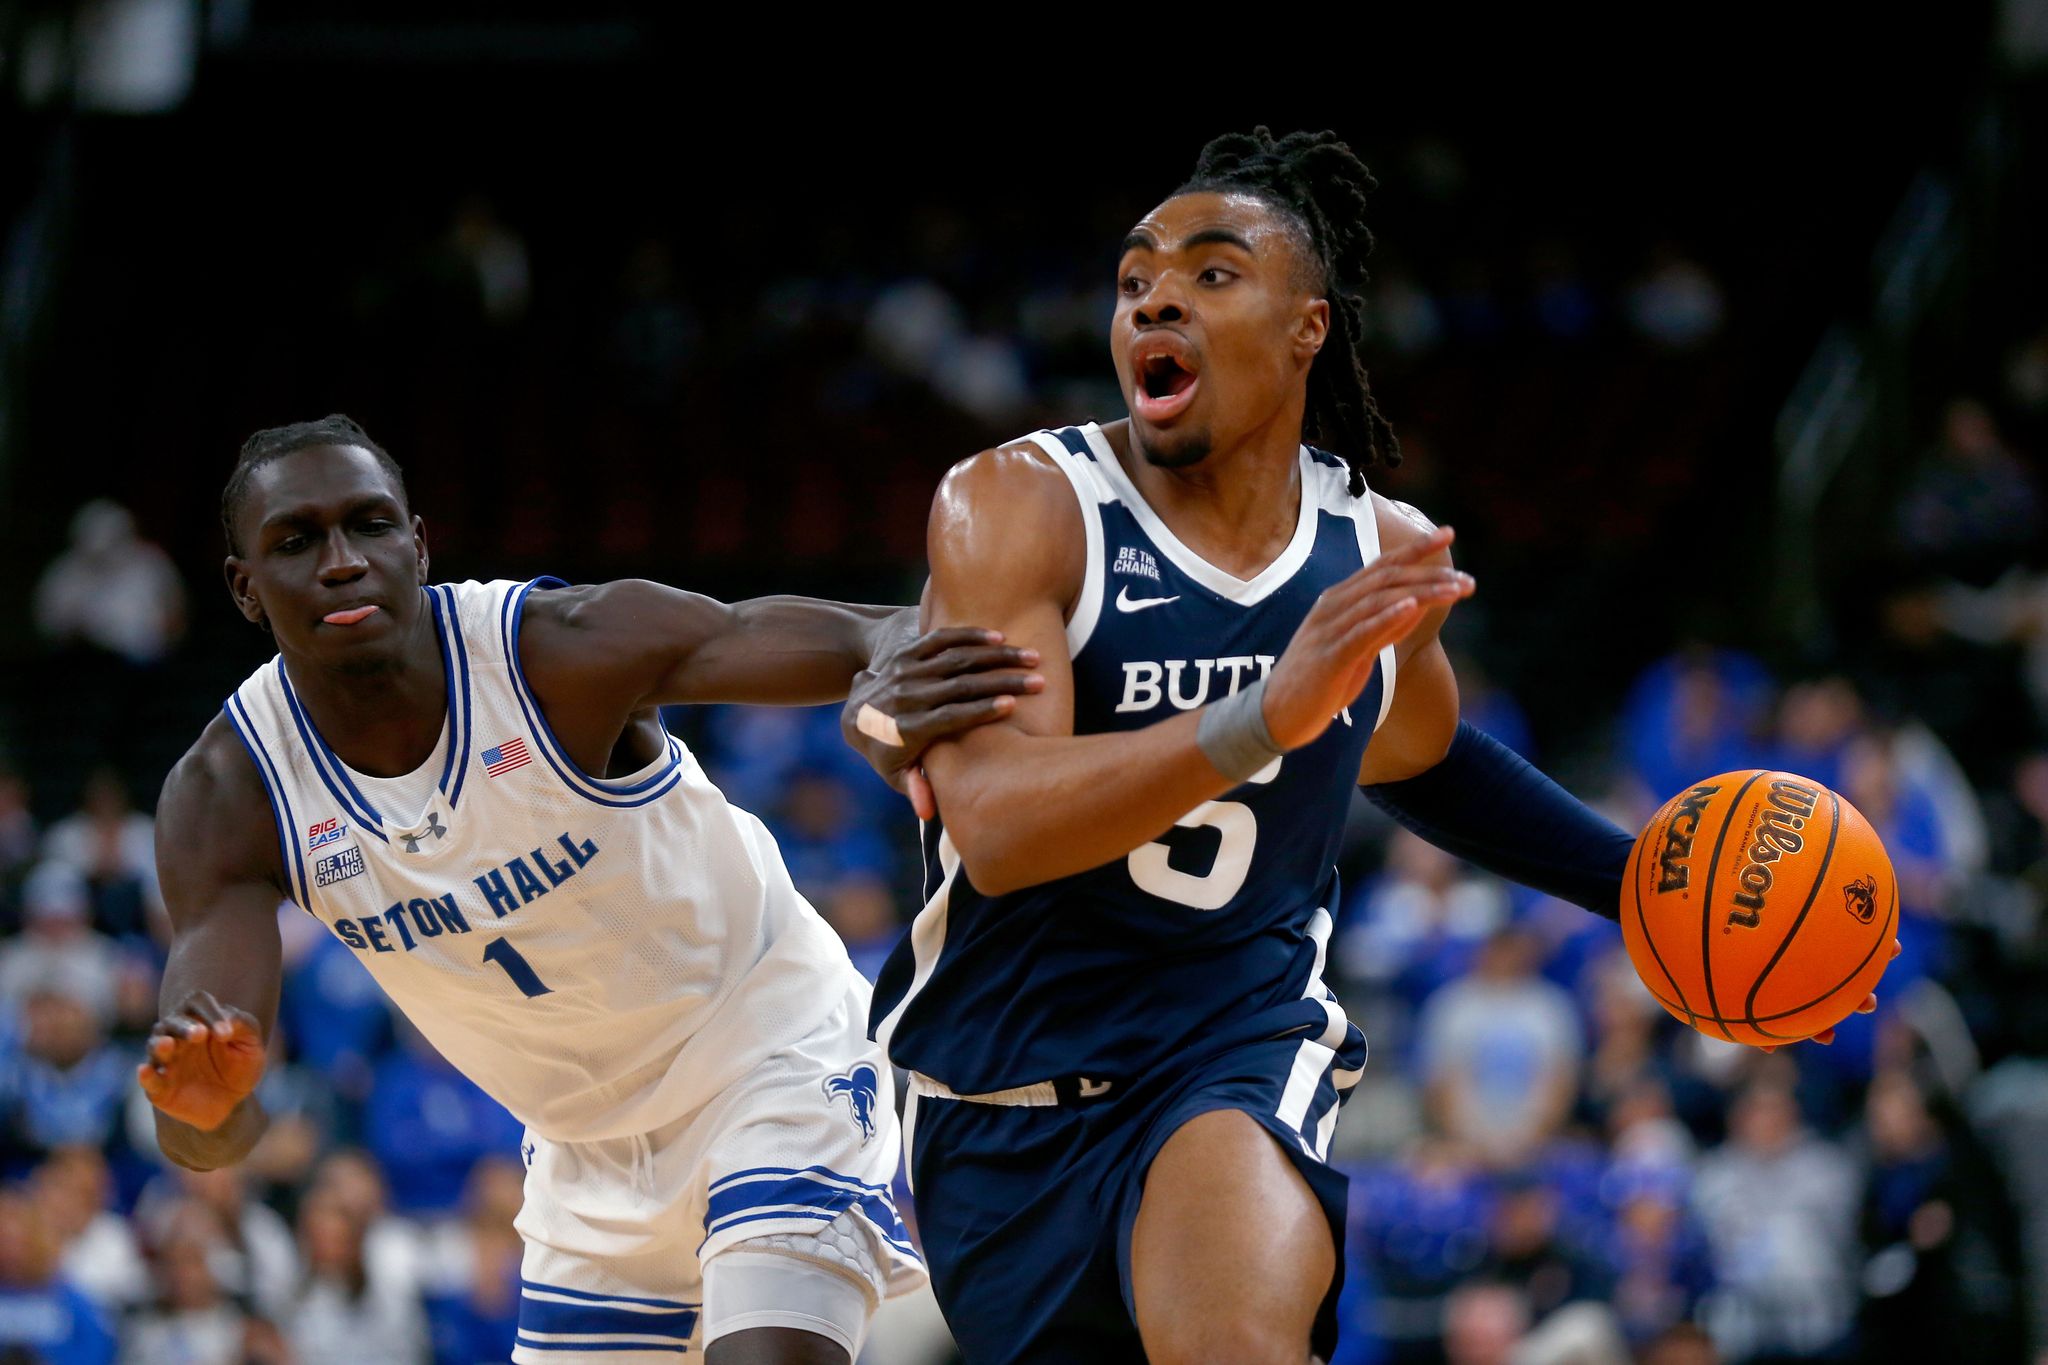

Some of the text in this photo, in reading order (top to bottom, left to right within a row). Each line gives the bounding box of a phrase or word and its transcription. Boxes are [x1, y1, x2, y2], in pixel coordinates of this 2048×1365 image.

[1113, 559, 1161, 581] CHANGE
[1118, 546, 1157, 569] BE THE
[308, 817, 337, 837] BIG
[308, 824, 348, 849] EAST
[1128, 755, 1283, 910] 5
[1658, 786, 1722, 894] NCAA
[317, 847, 360, 874] BE THE
[1728, 781, 1821, 929] Wilson
[315, 859, 364, 887] CHANGE
[1649, 862, 1657, 896] BALL
[334, 831, 600, 953] SETON HALL
[482, 936, 556, 999] 1
